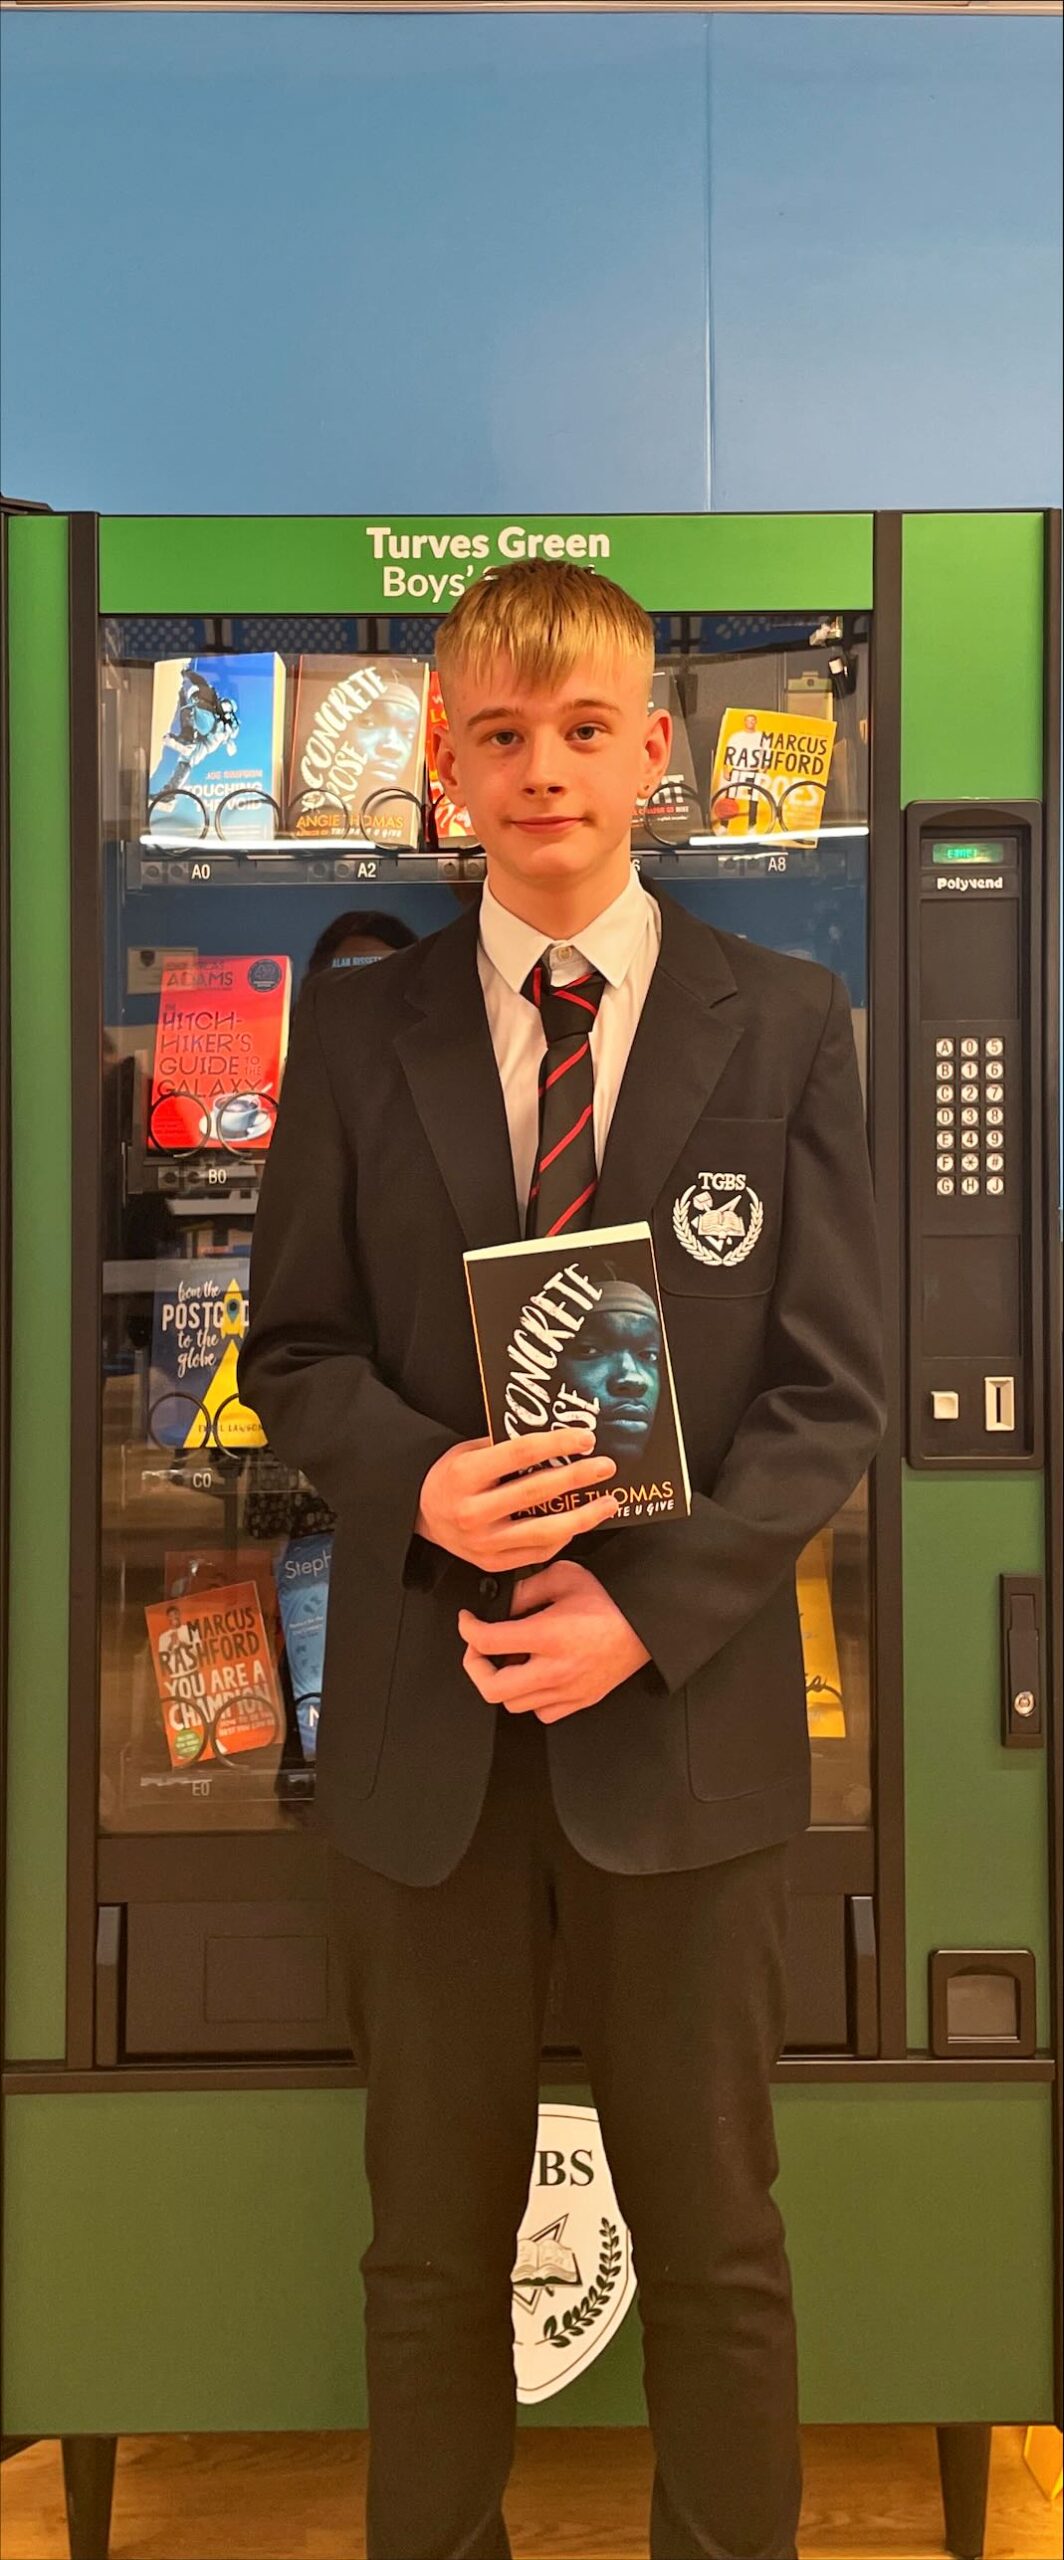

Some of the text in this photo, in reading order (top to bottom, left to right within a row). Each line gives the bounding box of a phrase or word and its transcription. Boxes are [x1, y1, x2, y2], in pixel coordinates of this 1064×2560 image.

[366, 526, 610, 559] Turves Green
[301, 667, 389, 789] CONCRETE
[760, 731, 827, 755] MARCUS
[724, 746, 824, 775] RASHFORD
[296, 814, 341, 829] ANGIE
[357, 863, 377, 878] A2
[630, 859, 641, 871] 6
[768, 857, 787, 871] A8
[937, 877, 1003, 891] Polyvend
[167, 972, 233, 987] ADAMS
[160, 1056, 260, 1076] GUIDE TO
[157, 1079, 262, 1098] GALAXY
[698, 1172, 747, 1190] TGBS
[201, 1279, 222, 1298] the
[177, 1329, 219, 1349] to the
[177, 1347, 217, 1379] globe
[585, 1481, 674, 1505] THOMAS
[634, 1505, 643, 1516] U
[647, 1499, 675, 1516] GIVE
[187, 1607, 255, 1643] MARCUS
[158, 1631, 260, 1675] RASHFORD
[164, 1659, 266, 1699] YOU ARE A
[168, 1683, 272, 1731] CHAMPION
[536, 2149, 594, 2187] BS
